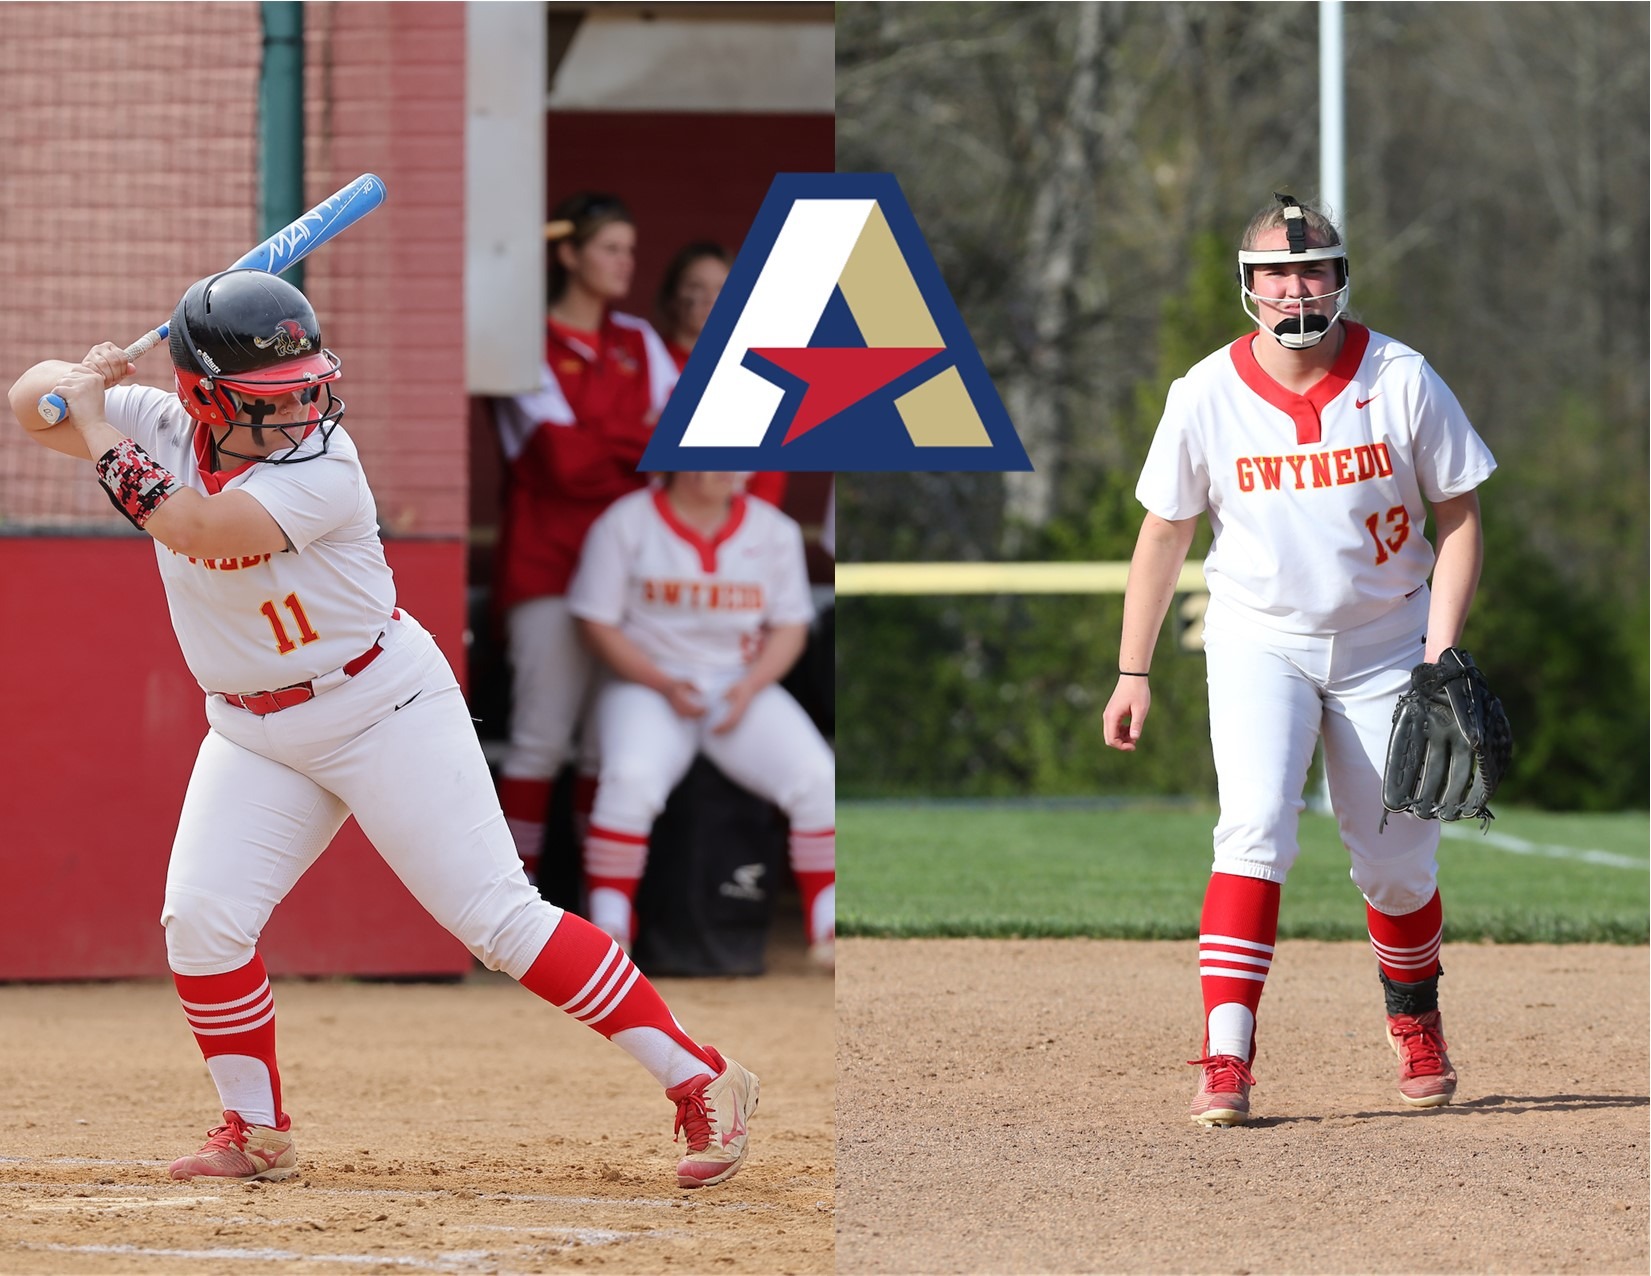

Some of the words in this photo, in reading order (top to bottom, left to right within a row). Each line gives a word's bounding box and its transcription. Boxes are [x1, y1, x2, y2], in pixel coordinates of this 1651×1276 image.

[1235, 442, 1394, 493] GWYNEDD
[1365, 504, 1411, 566] 13
[259, 591, 320, 656] 11
